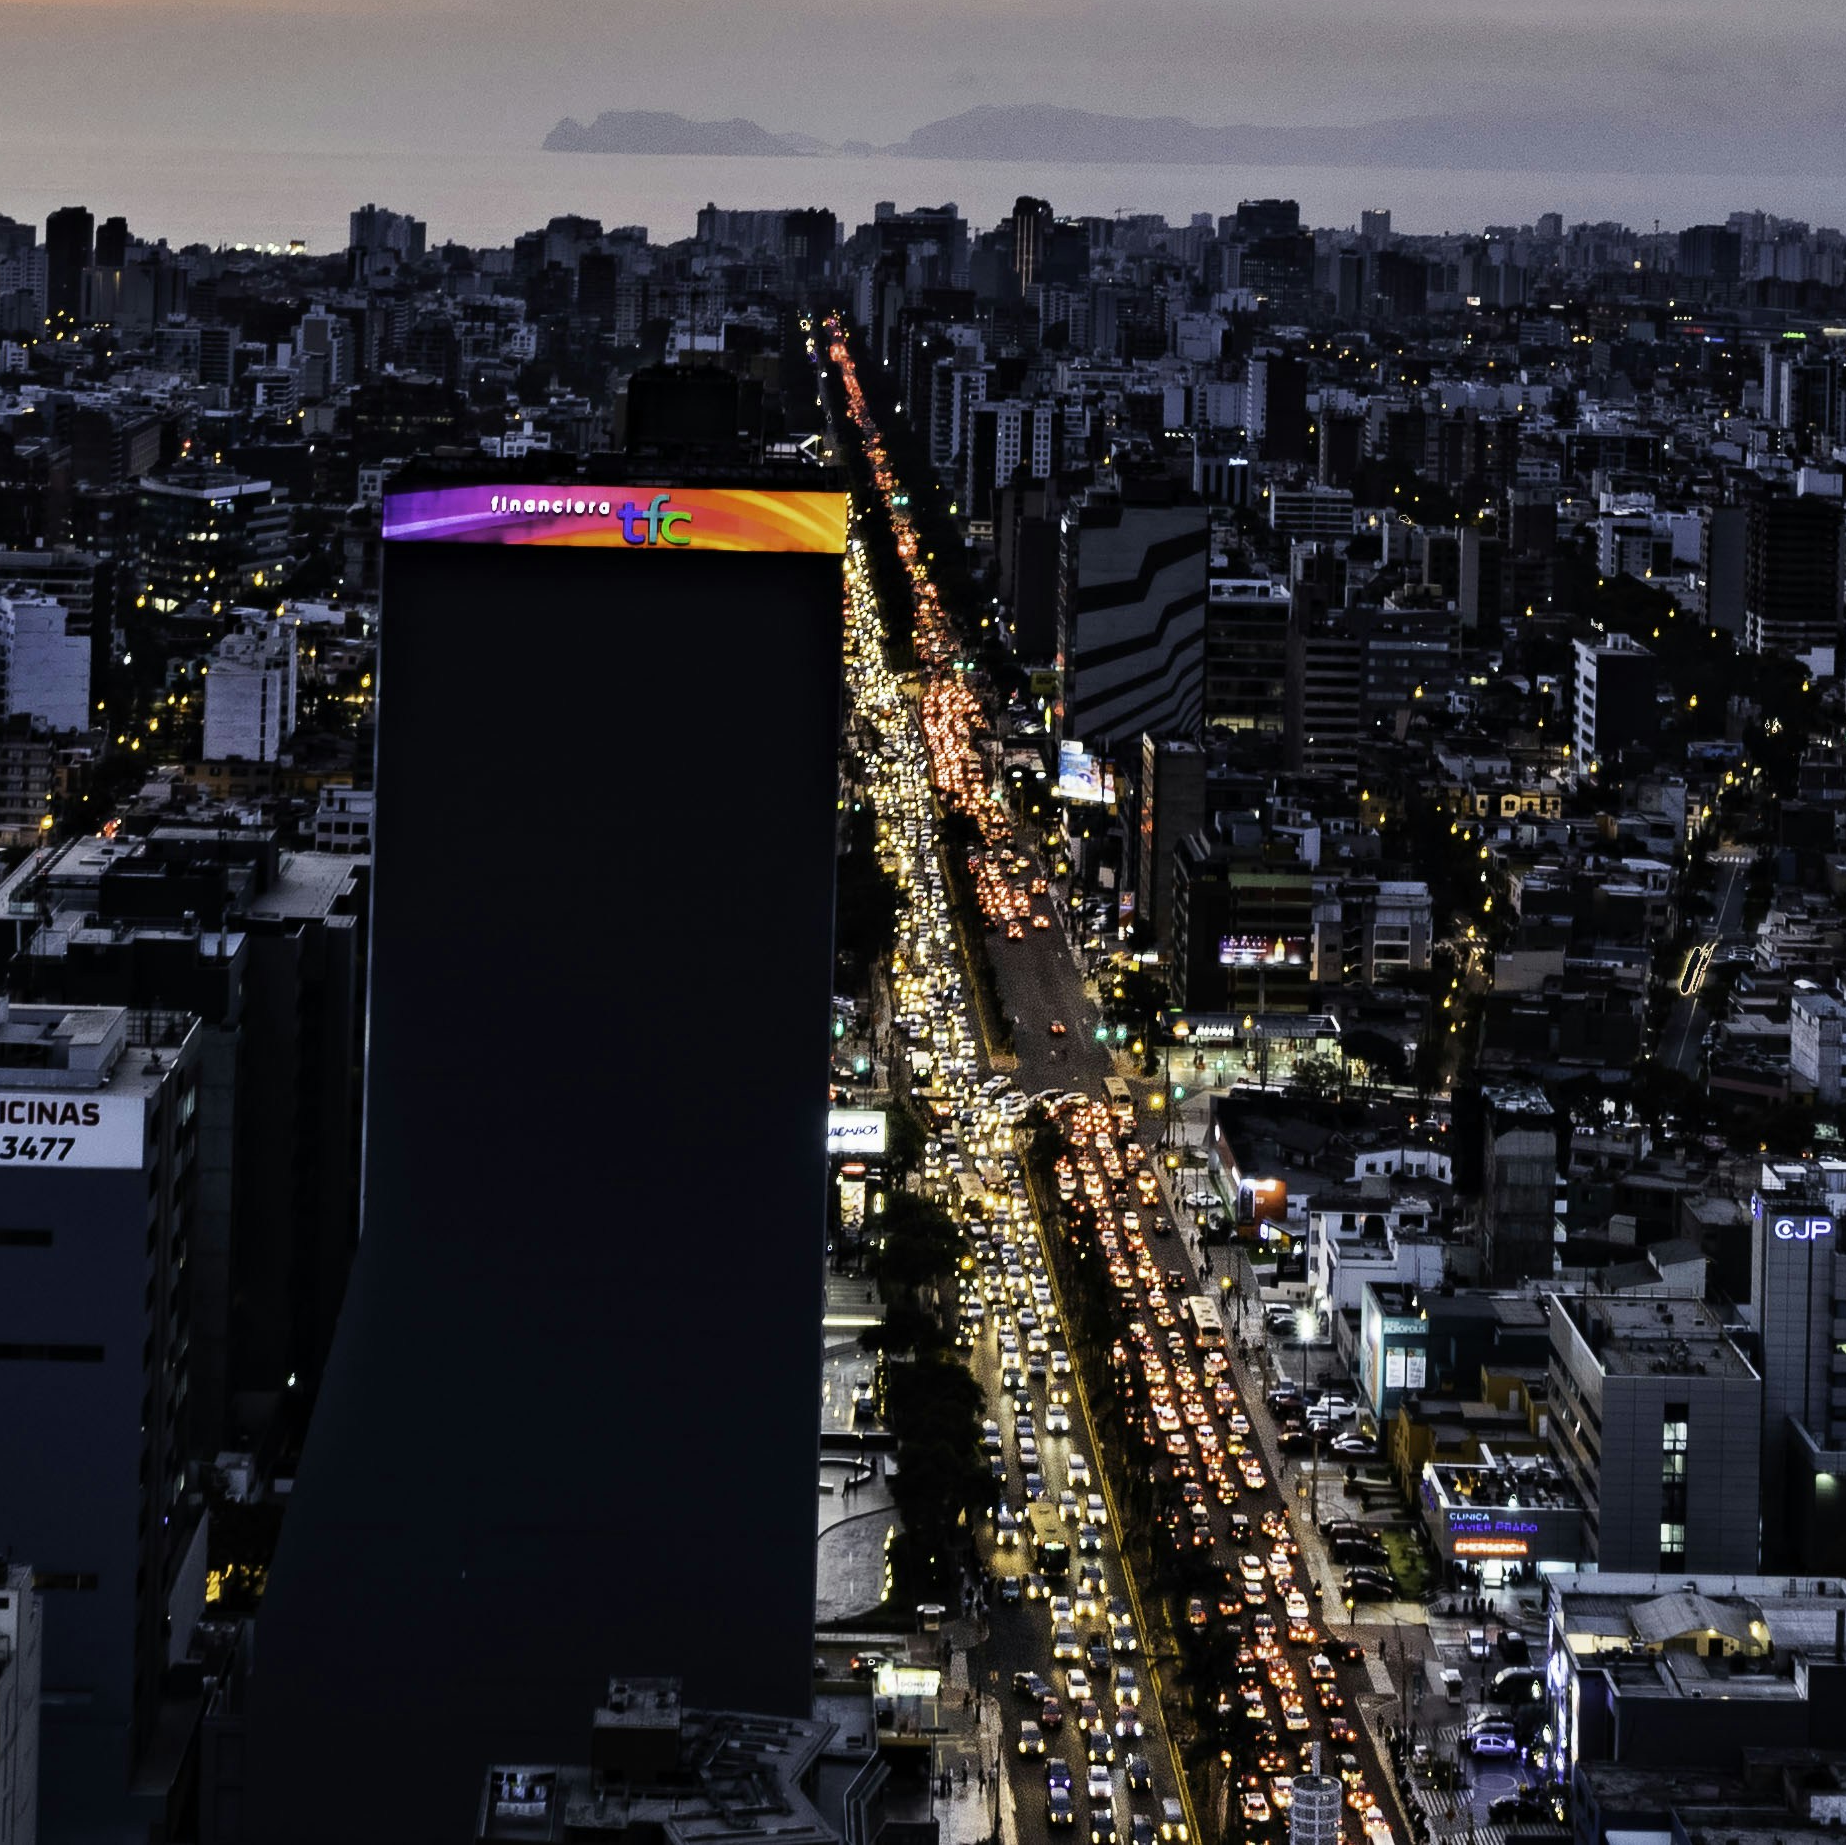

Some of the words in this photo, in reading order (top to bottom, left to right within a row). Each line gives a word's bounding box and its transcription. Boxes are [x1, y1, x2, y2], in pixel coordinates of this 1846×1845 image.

[490, 495, 611, 516] financiera
[617, 494, 692, 545] tfc
[1775, 1219, 1832, 1241] CJP
[1449, 1512, 1490, 1522] CLINICA
[1450, 1522, 1492, 1532] JAVIER
[1495, 1521, 1538, 1533] PRADO
